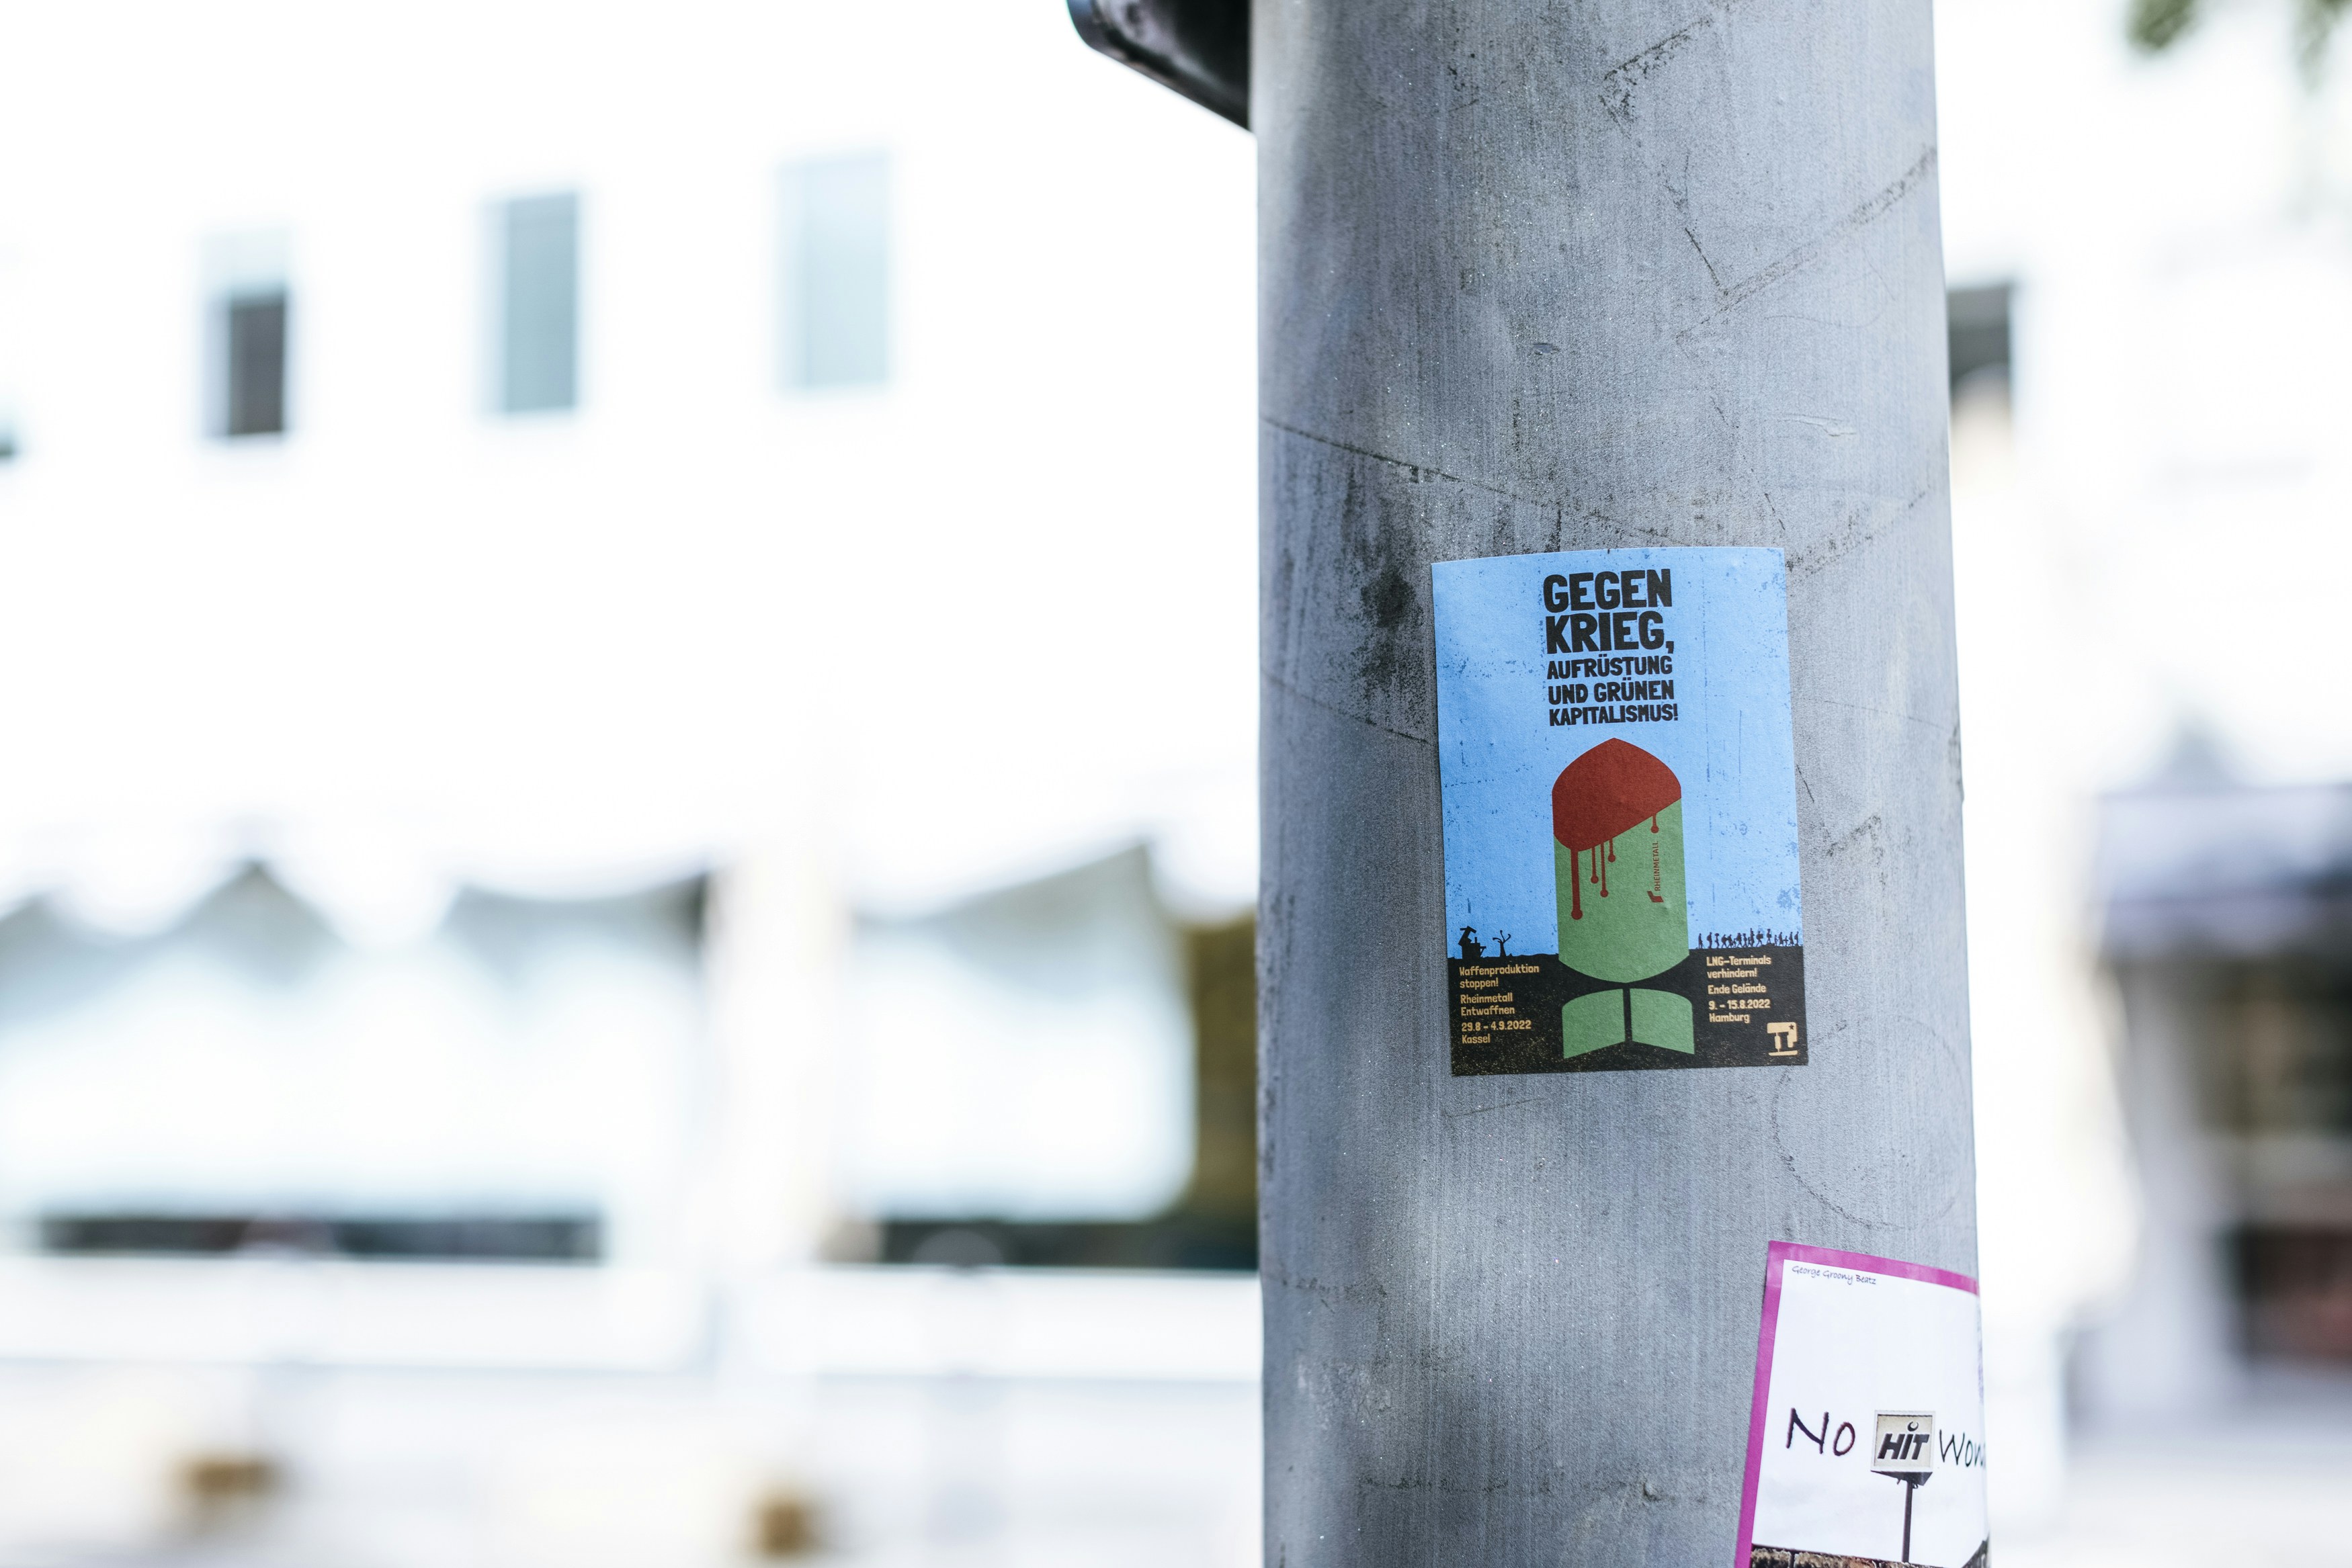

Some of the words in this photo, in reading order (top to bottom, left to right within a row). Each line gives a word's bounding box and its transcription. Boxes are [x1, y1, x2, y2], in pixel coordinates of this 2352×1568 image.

[1543, 568, 1673, 613] GEGEN
[1546, 611, 1675, 654] KRIEG,
[1546, 654, 1673, 680] AUFRÜSTUNG
[1548, 683, 1588, 705] UND
[1593, 677, 1674, 703] GRÜNEN
[1549, 703, 1678, 726] KAPITALISMUS!
[1652, 840, 1661, 891] RHEINMETALL
[1706, 955, 1771, 967] LNG-Terminals
[1459, 963, 1540, 977] Waffenproduktion
[1707, 967, 1758, 979] verhindern!
[1460, 977, 1499, 990] stoppen!
[1708, 984, 1730, 995] Ende
[1732, 983, 1767, 994] Gelände
[1460, 992, 1513, 1004] Rheinmetall
[1727, 998, 1771, 1010] 15.8.2022
[1461, 1005, 1515, 1016] Entwaffnen
[1709, 1012, 1751, 1024] Hamburg
[1462, 1022, 1481, 1032] 29.8
[1490, 1020, 1532, 1031] 4.9.2022
[1462, 1033, 1490, 1044] Kassel
[1792, 1265, 1820, 1278] George
[1786, 1407, 1855, 1456] No
